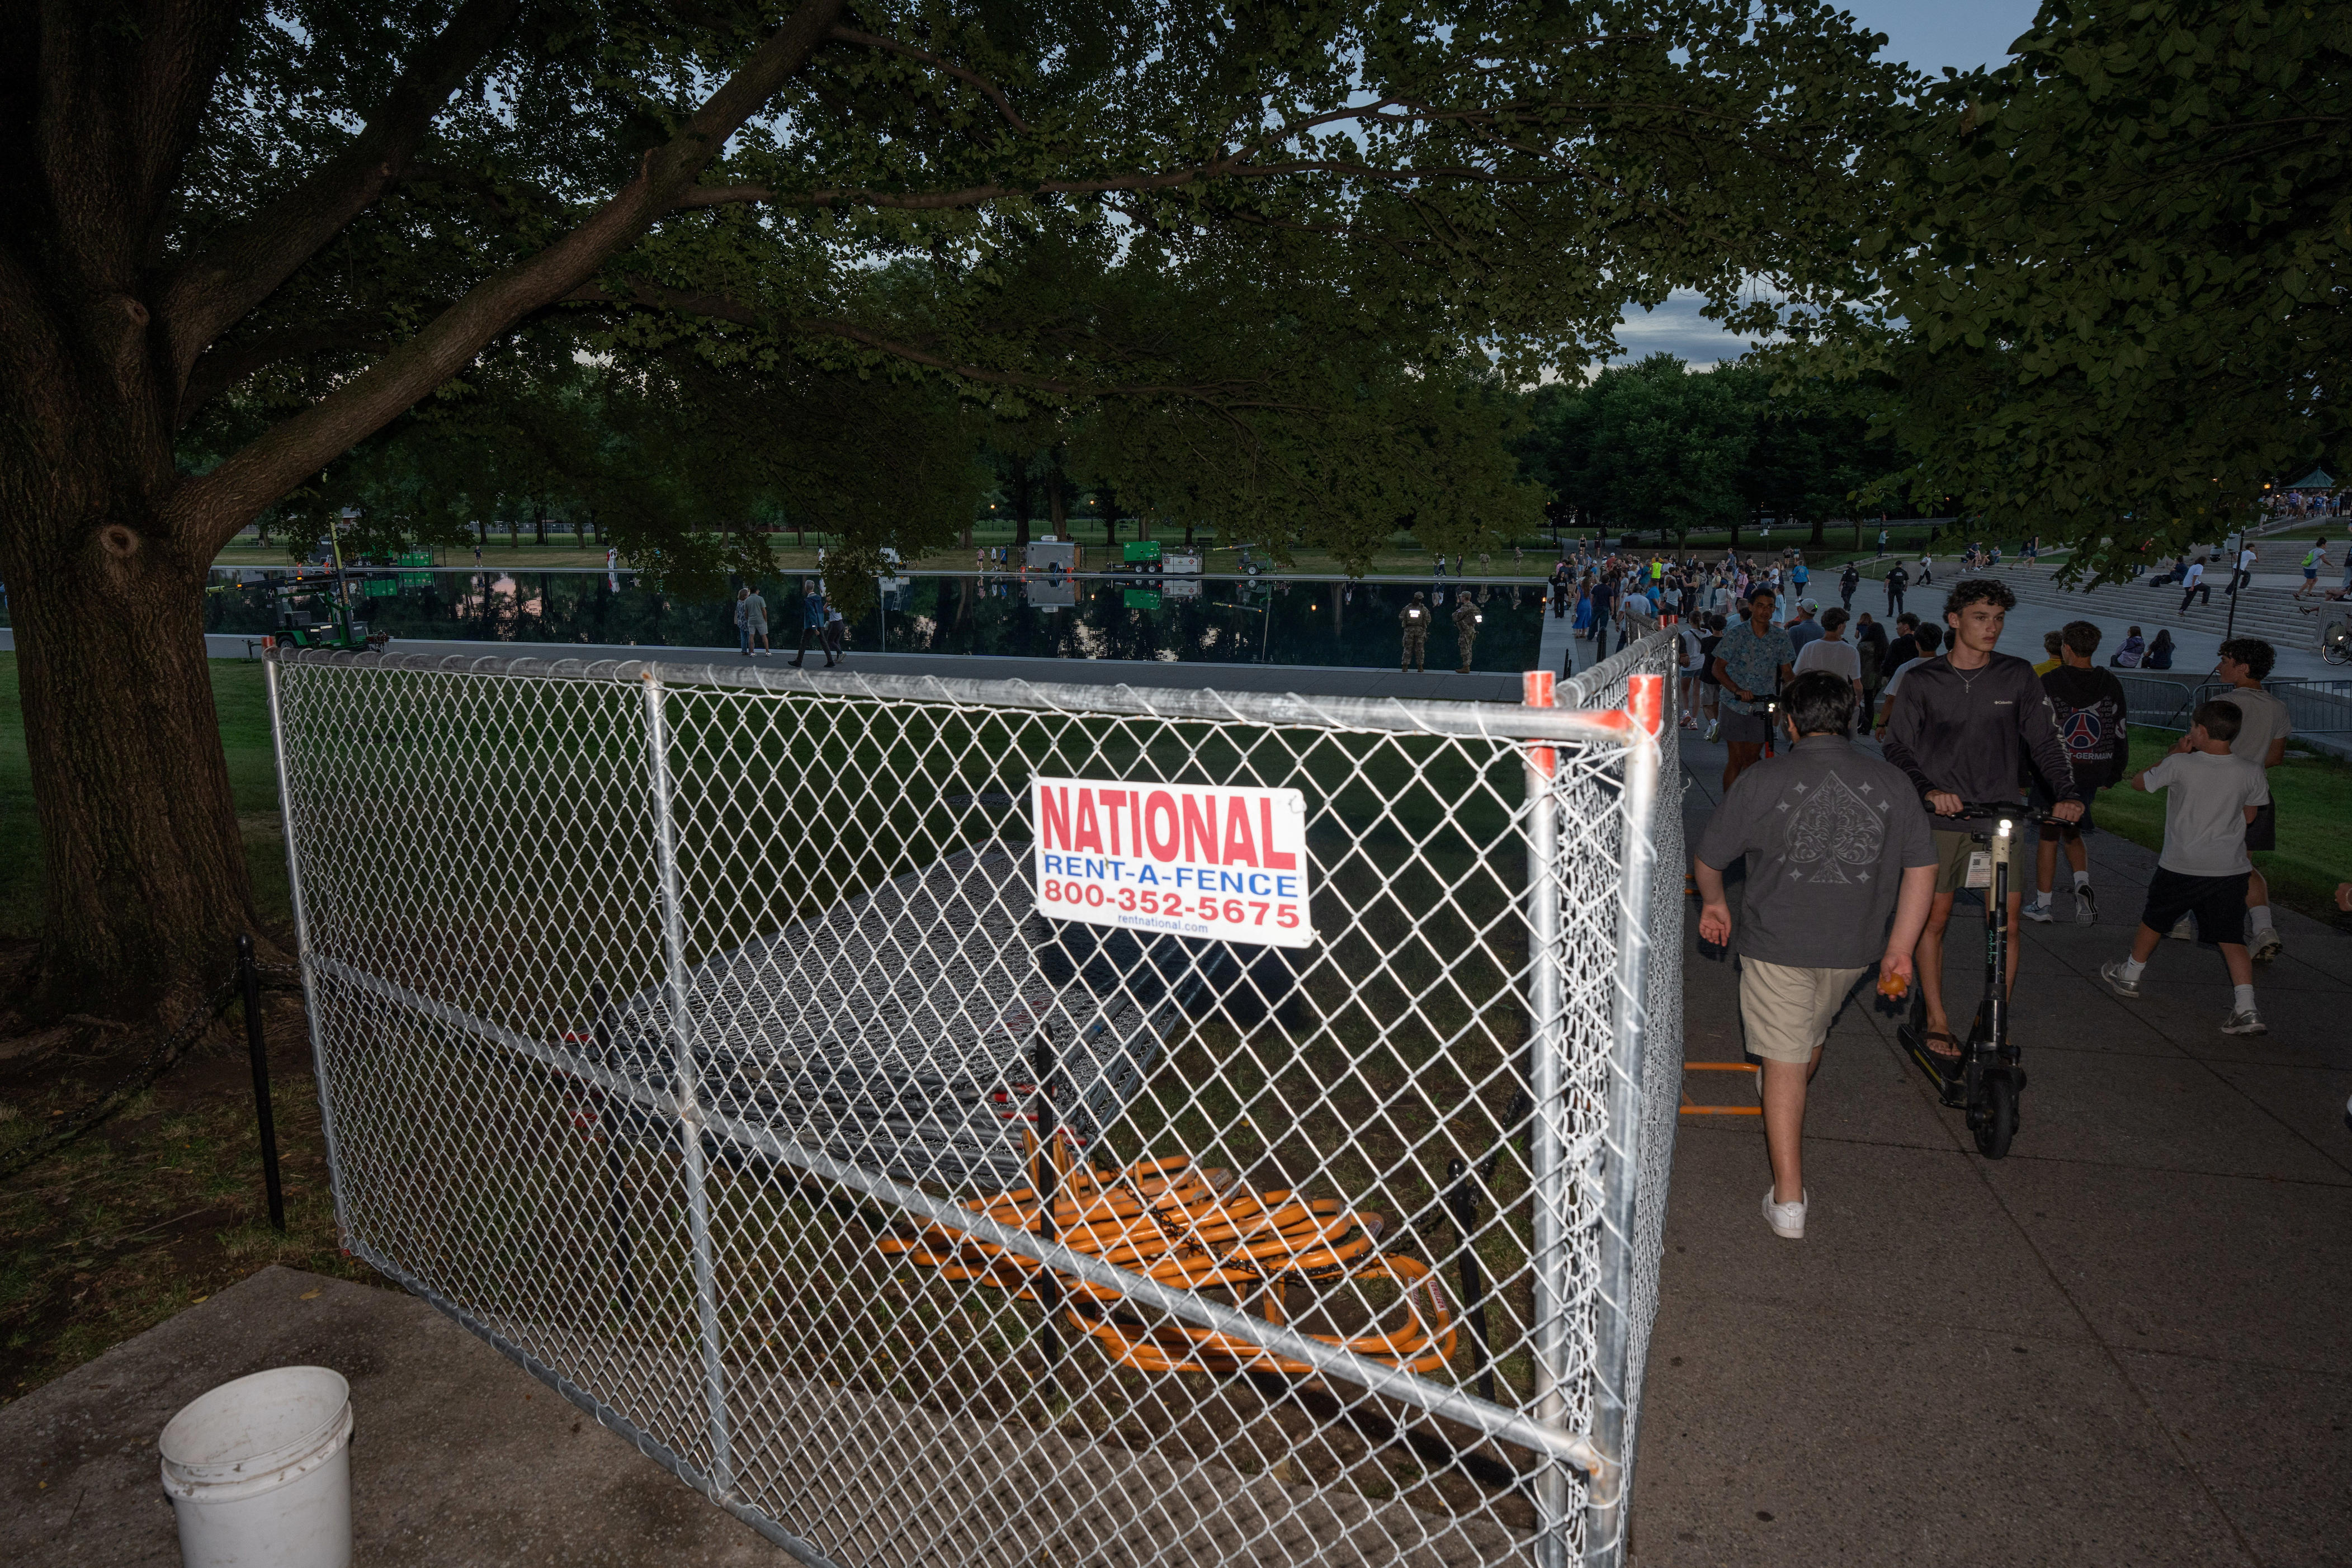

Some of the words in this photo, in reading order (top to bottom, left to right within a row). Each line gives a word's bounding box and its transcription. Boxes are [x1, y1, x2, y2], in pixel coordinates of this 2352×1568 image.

[1041, 785, 1297, 871] NATIONAL
[1044, 854, 1298, 898] RENT-A-FENCE
[1044, 879, 1300, 929] 800-352-5675
[1118, 914, 1208, 933] rentnational.com
